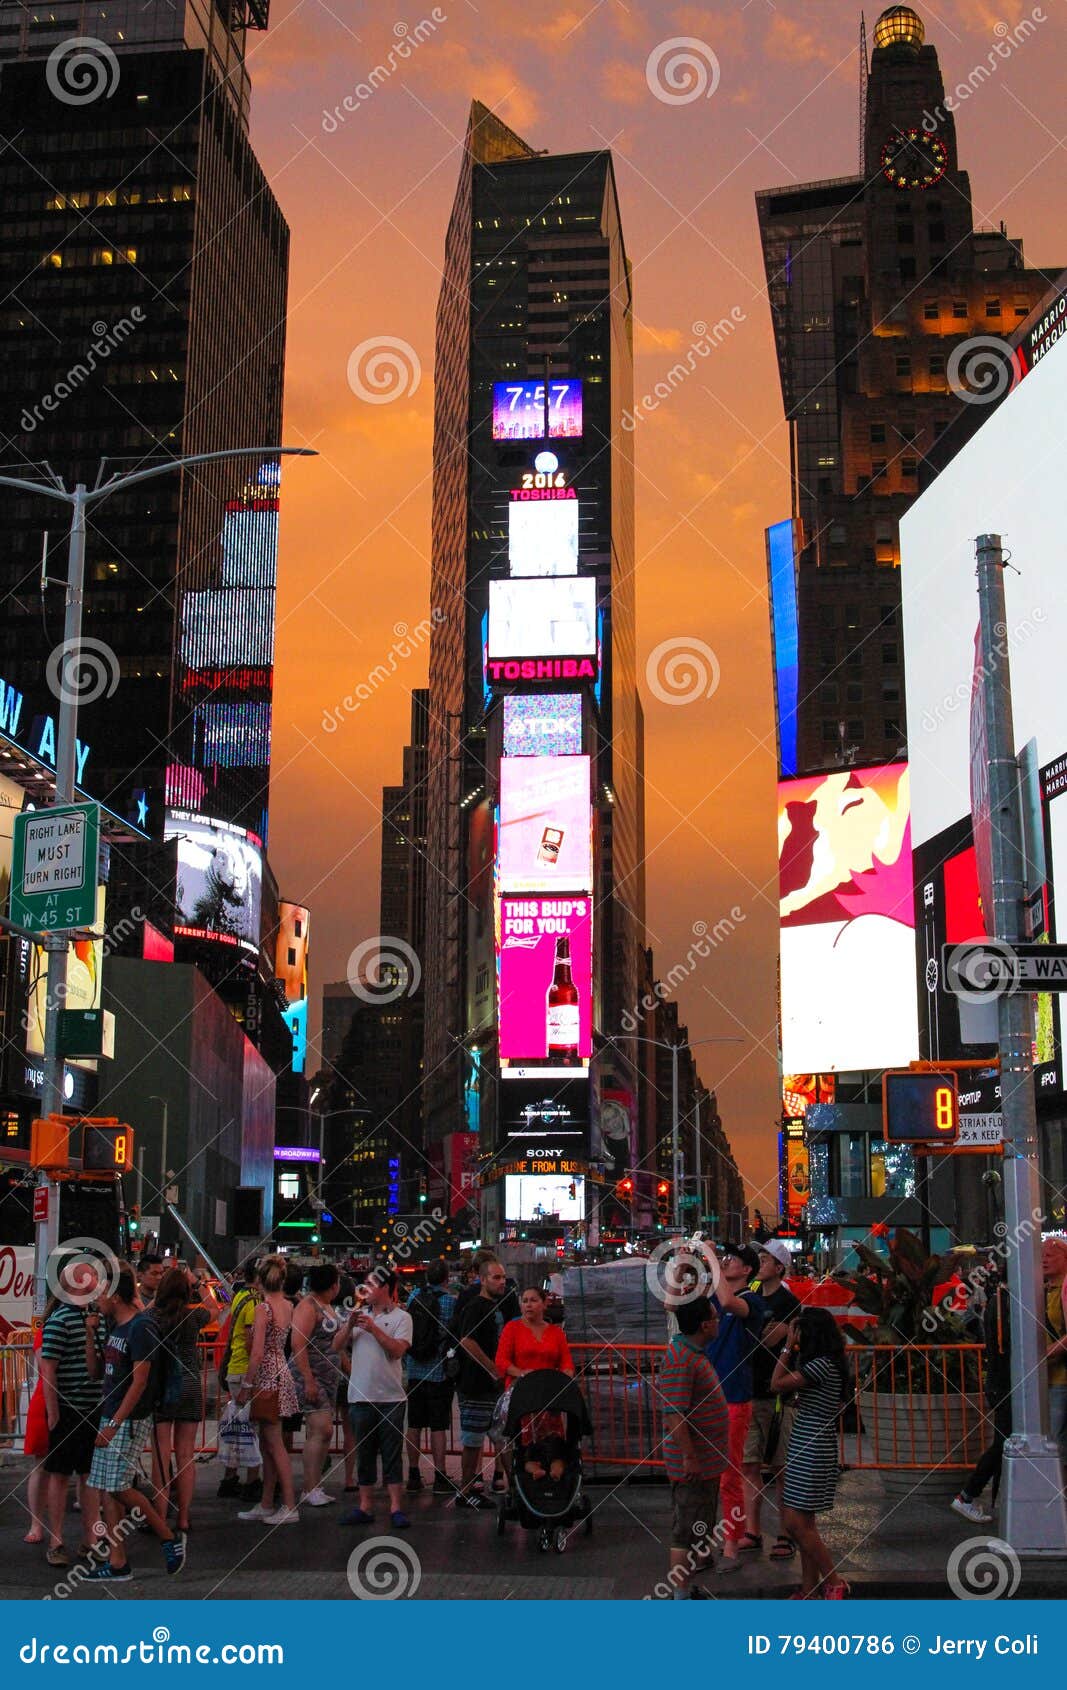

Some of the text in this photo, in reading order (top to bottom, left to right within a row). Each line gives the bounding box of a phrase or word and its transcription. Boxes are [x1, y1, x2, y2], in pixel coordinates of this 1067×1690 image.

[1031, 293, 1067, 347] MARRIO
[506, 385, 570, 411] 7:57
[522, 473, 566, 488] 2016
[511, 488, 577, 500] TOSHIBA
[489, 660, 594, 680] TOSHIBA
[523, 718, 577, 734] TDK
[170, 810, 191, 821] THEY
[191, 814, 210, 826] LOVE
[29, 822, 81, 840] RIGHT LANE
[38, 844, 70, 861] MUST
[25, 866, 82, 884] TURN RIGHT
[46, 894, 59, 906] AT
[504, 901, 586, 917] THIS BUD'S
[23, 907, 82, 928] W 45 ST
[504, 918, 571, 934] FOR YOU.
[989, 959, 1028, 978] ONE
[935, 1087, 953, 1129] 8
[981, 1130, 1000, 1140] KEEP
[114, 1135, 126, 1164] 8
[526, 1149, 565, 1157] SONY
[531, 1160, 556, 1173] FROM
